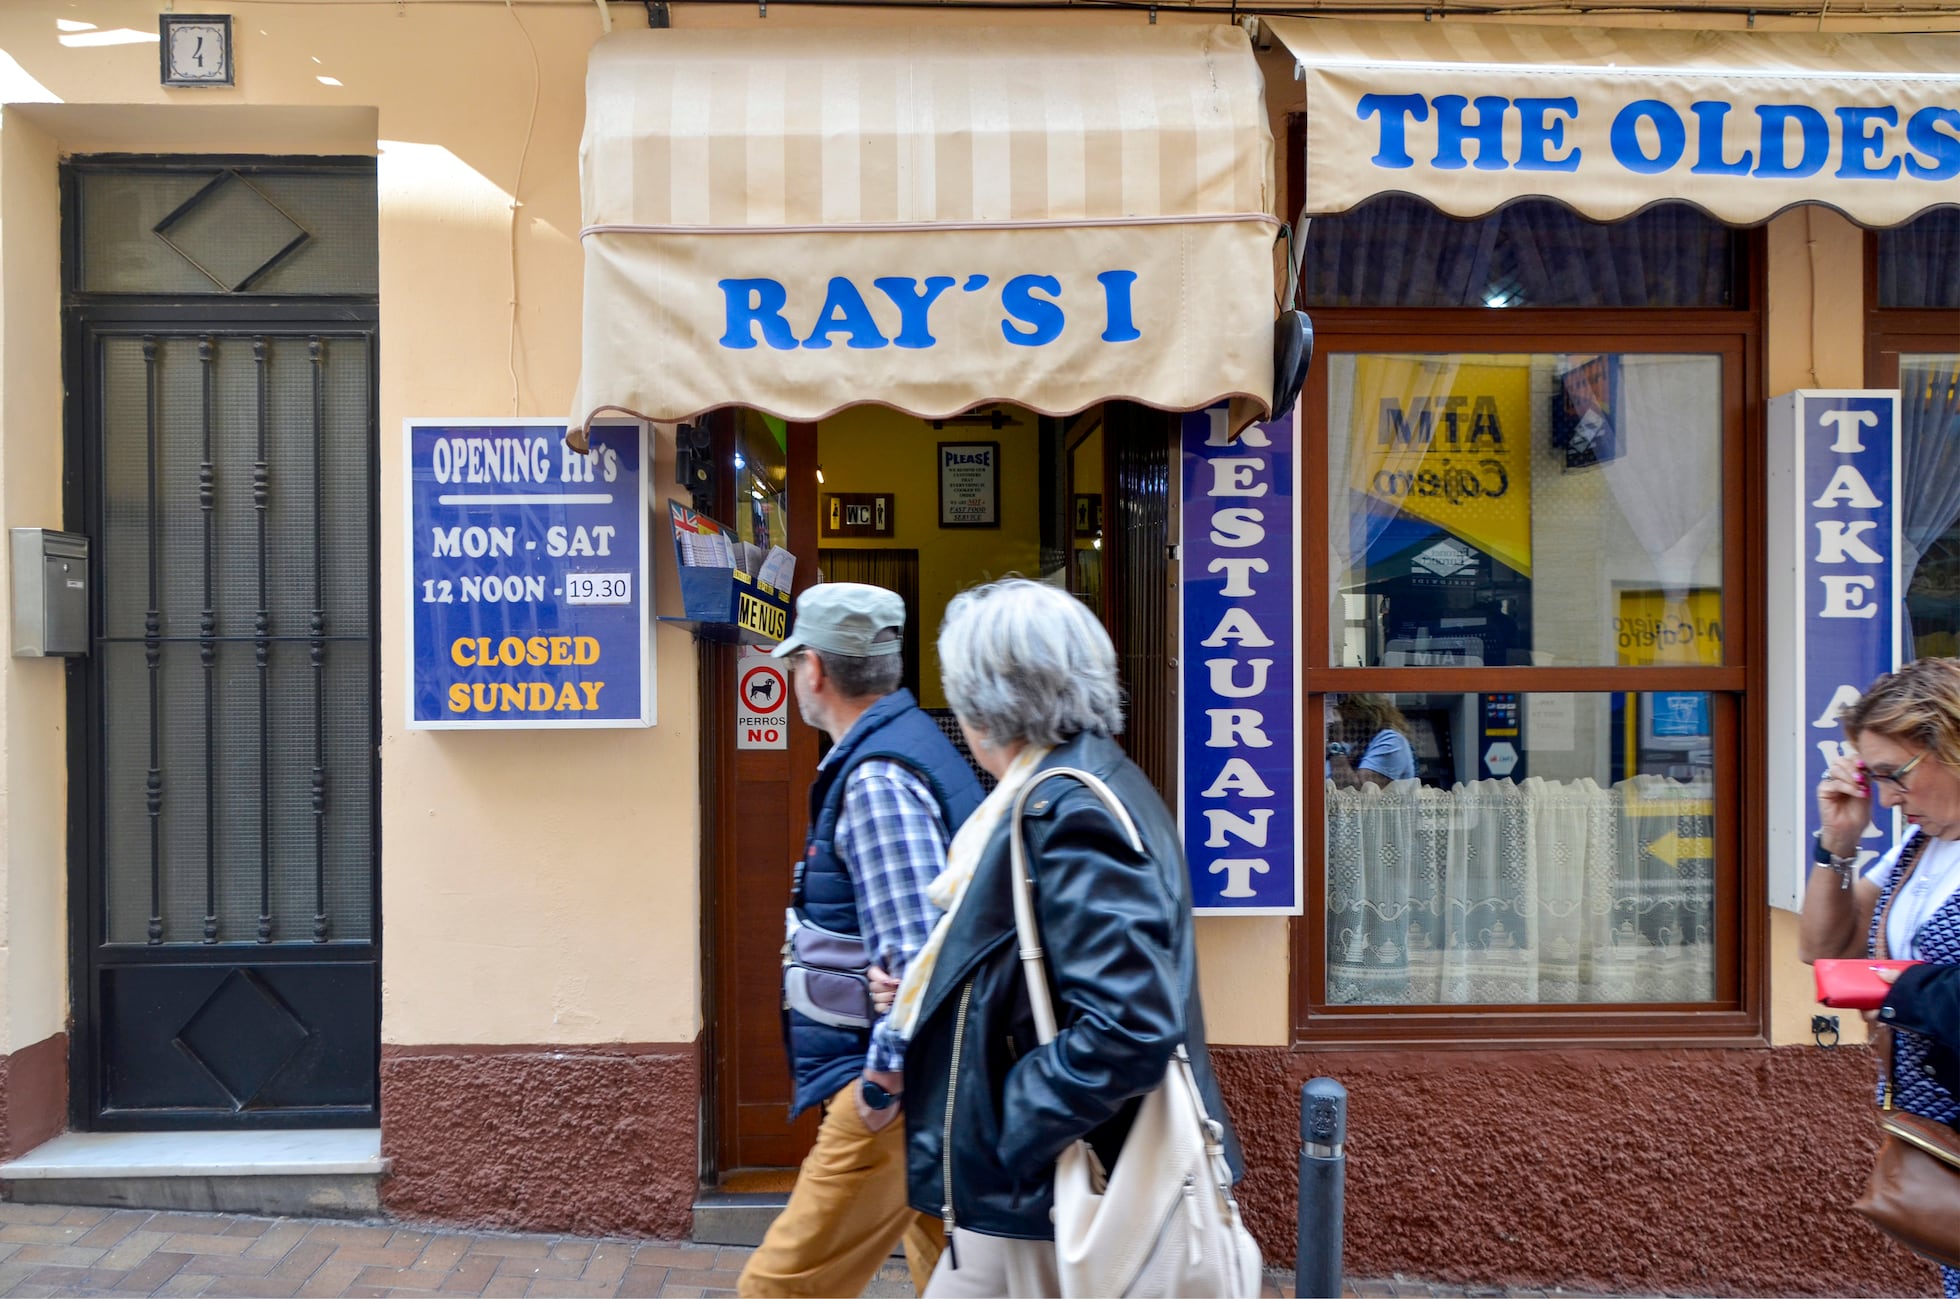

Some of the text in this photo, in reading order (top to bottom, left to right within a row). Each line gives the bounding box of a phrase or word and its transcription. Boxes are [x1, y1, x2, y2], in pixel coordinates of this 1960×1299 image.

[192, 36, 203, 67] 4
[1356, 92, 1960, 182] THE OLDES
[717, 269, 1141, 350] RAY'S I
[432, 437, 550, 484] OPENING
[945, 450, 990, 467] PLEASE
[847, 506, 869, 523] WC
[1812, 409, 1884, 619] TAKE
[432, 526, 515, 558] MON
[546, 525, 615, 556] SAT
[422, 579, 453, 604] 12
[460, 575, 545, 603] NOON
[569, 579, 626, 598] 19.30
[739, 596, 785, 639] MENUS
[451, 636, 600, 667] CLOSED
[448, 681, 605, 712] SUNDAY
[739, 717, 786, 726] PERROS
[747, 729, 779, 742] NO
